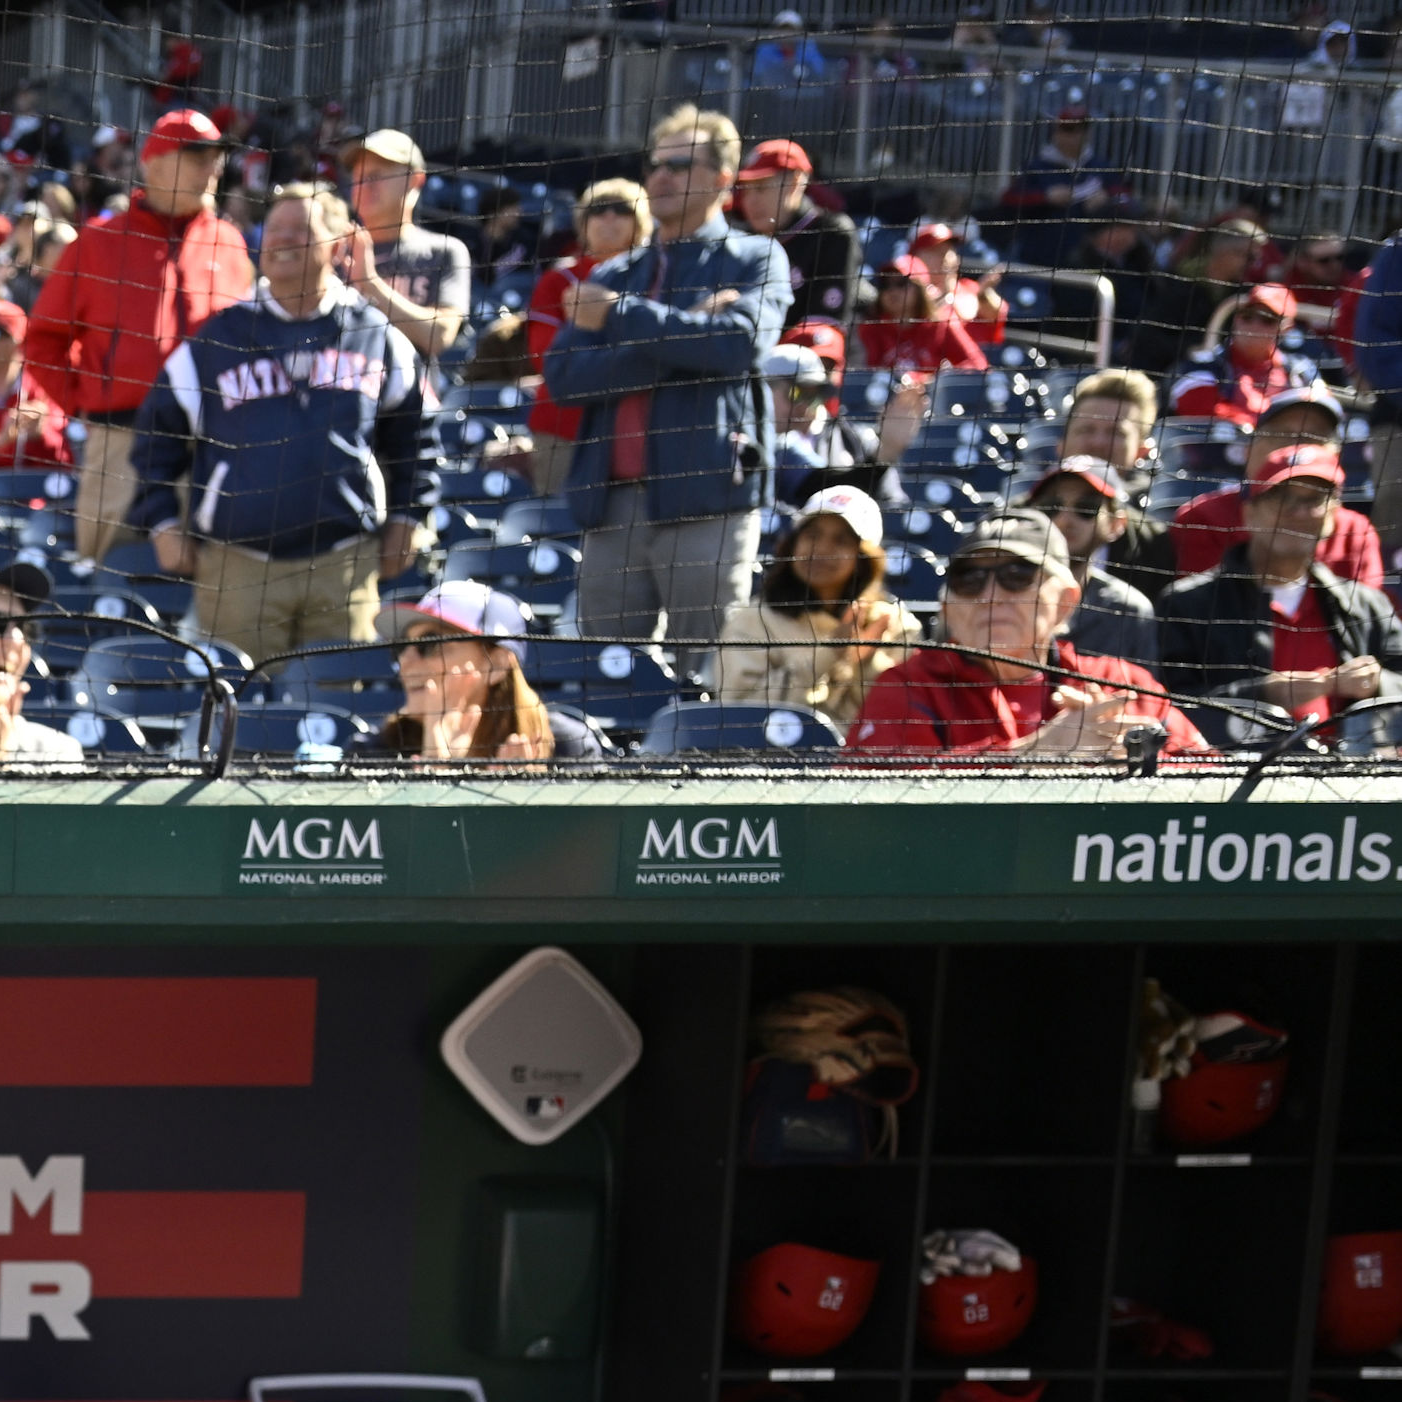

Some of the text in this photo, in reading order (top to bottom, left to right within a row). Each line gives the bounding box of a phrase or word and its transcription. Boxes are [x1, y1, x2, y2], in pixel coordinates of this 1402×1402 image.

[242, 818, 384, 860] MGM
[639, 816, 782, 860] MGM
[239, 872, 315, 885] NATIONAL
[636, 873, 712, 884] NATIONAL
